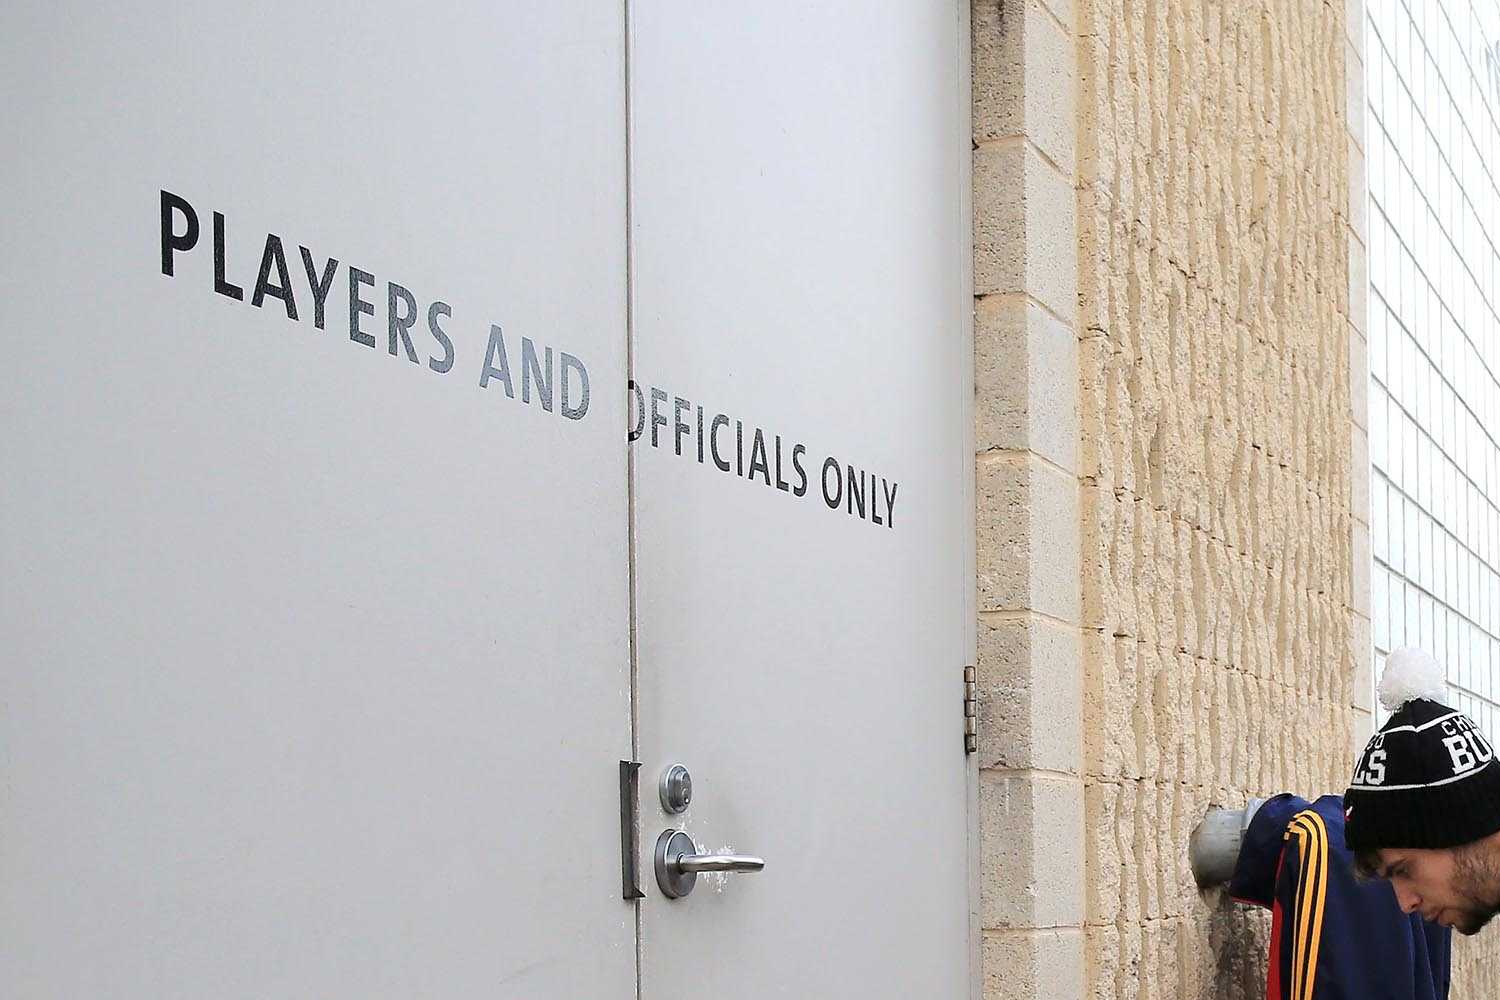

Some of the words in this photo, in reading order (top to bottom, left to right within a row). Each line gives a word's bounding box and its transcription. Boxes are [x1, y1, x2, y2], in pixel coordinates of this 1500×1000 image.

[160, 189, 455, 374] PLAYERS
[479, 323, 590, 421] AND
[627, 379, 808, 498] OFFICIALS
[821, 456, 897, 528] ONLY
